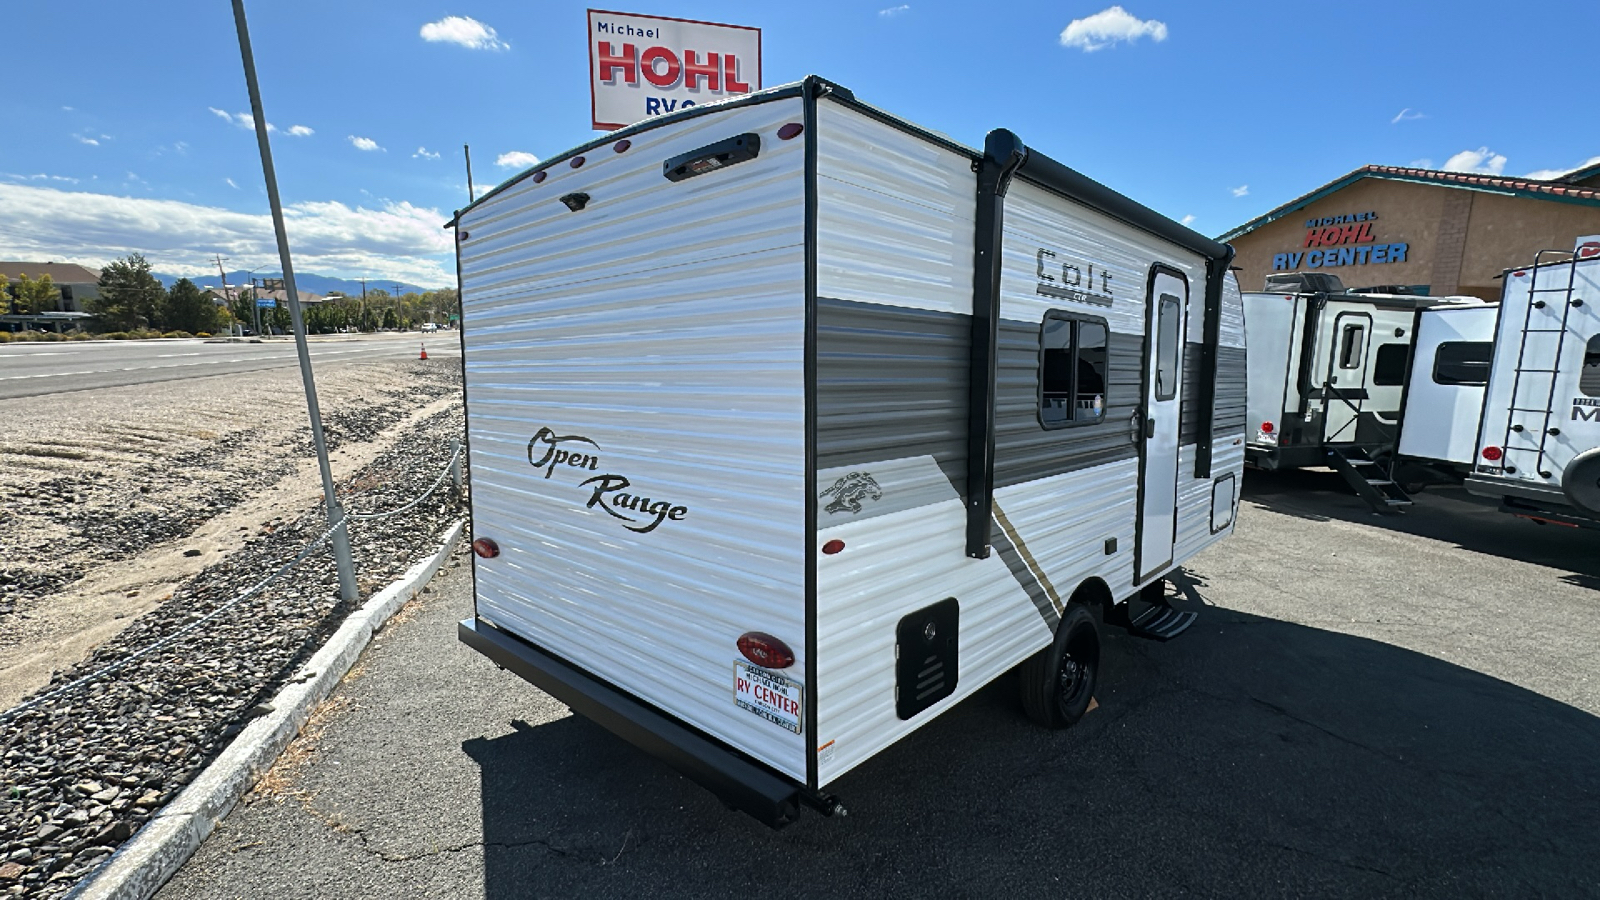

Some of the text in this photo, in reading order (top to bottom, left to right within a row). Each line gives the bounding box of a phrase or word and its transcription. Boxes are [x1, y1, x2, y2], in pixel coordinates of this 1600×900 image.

[597, 22, 660, 39] Michael
[598, 41, 750, 95] HOHL
[646, 97, 677, 115] RV
[1305, 212, 1378, 228] MICHAEL
[1303, 223, 1376, 248] HOHL
[1272, 243, 1409, 270] RV CENTER
[1036, 248, 1113, 295] Colt
[527, 426, 602, 479] Open
[577, 473, 688, 534] Range
[754, 685, 799, 717] CENTER
